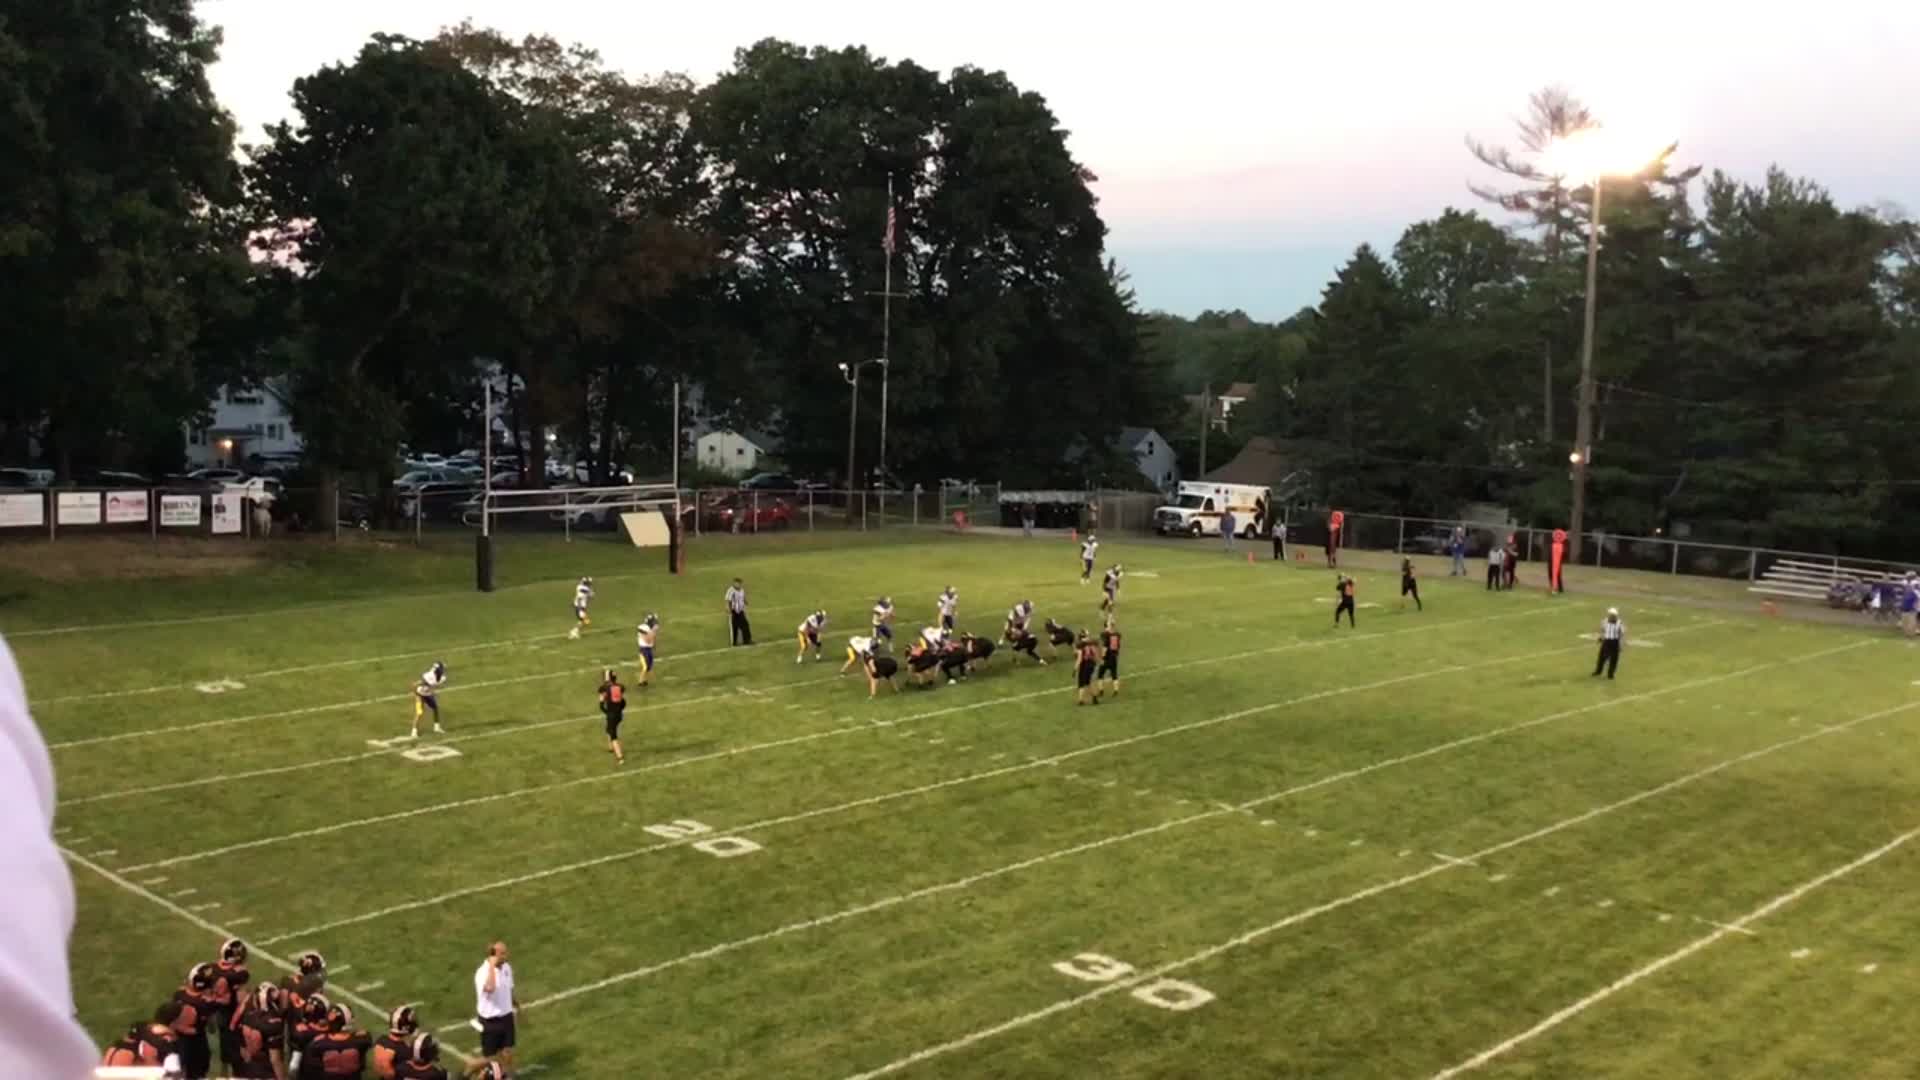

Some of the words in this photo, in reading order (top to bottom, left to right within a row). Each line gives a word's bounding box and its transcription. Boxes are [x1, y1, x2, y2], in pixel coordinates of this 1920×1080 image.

[365, 735, 463, 761] 10
[642, 819, 763, 858] 20
[1051, 952, 1217, 1012] 30
